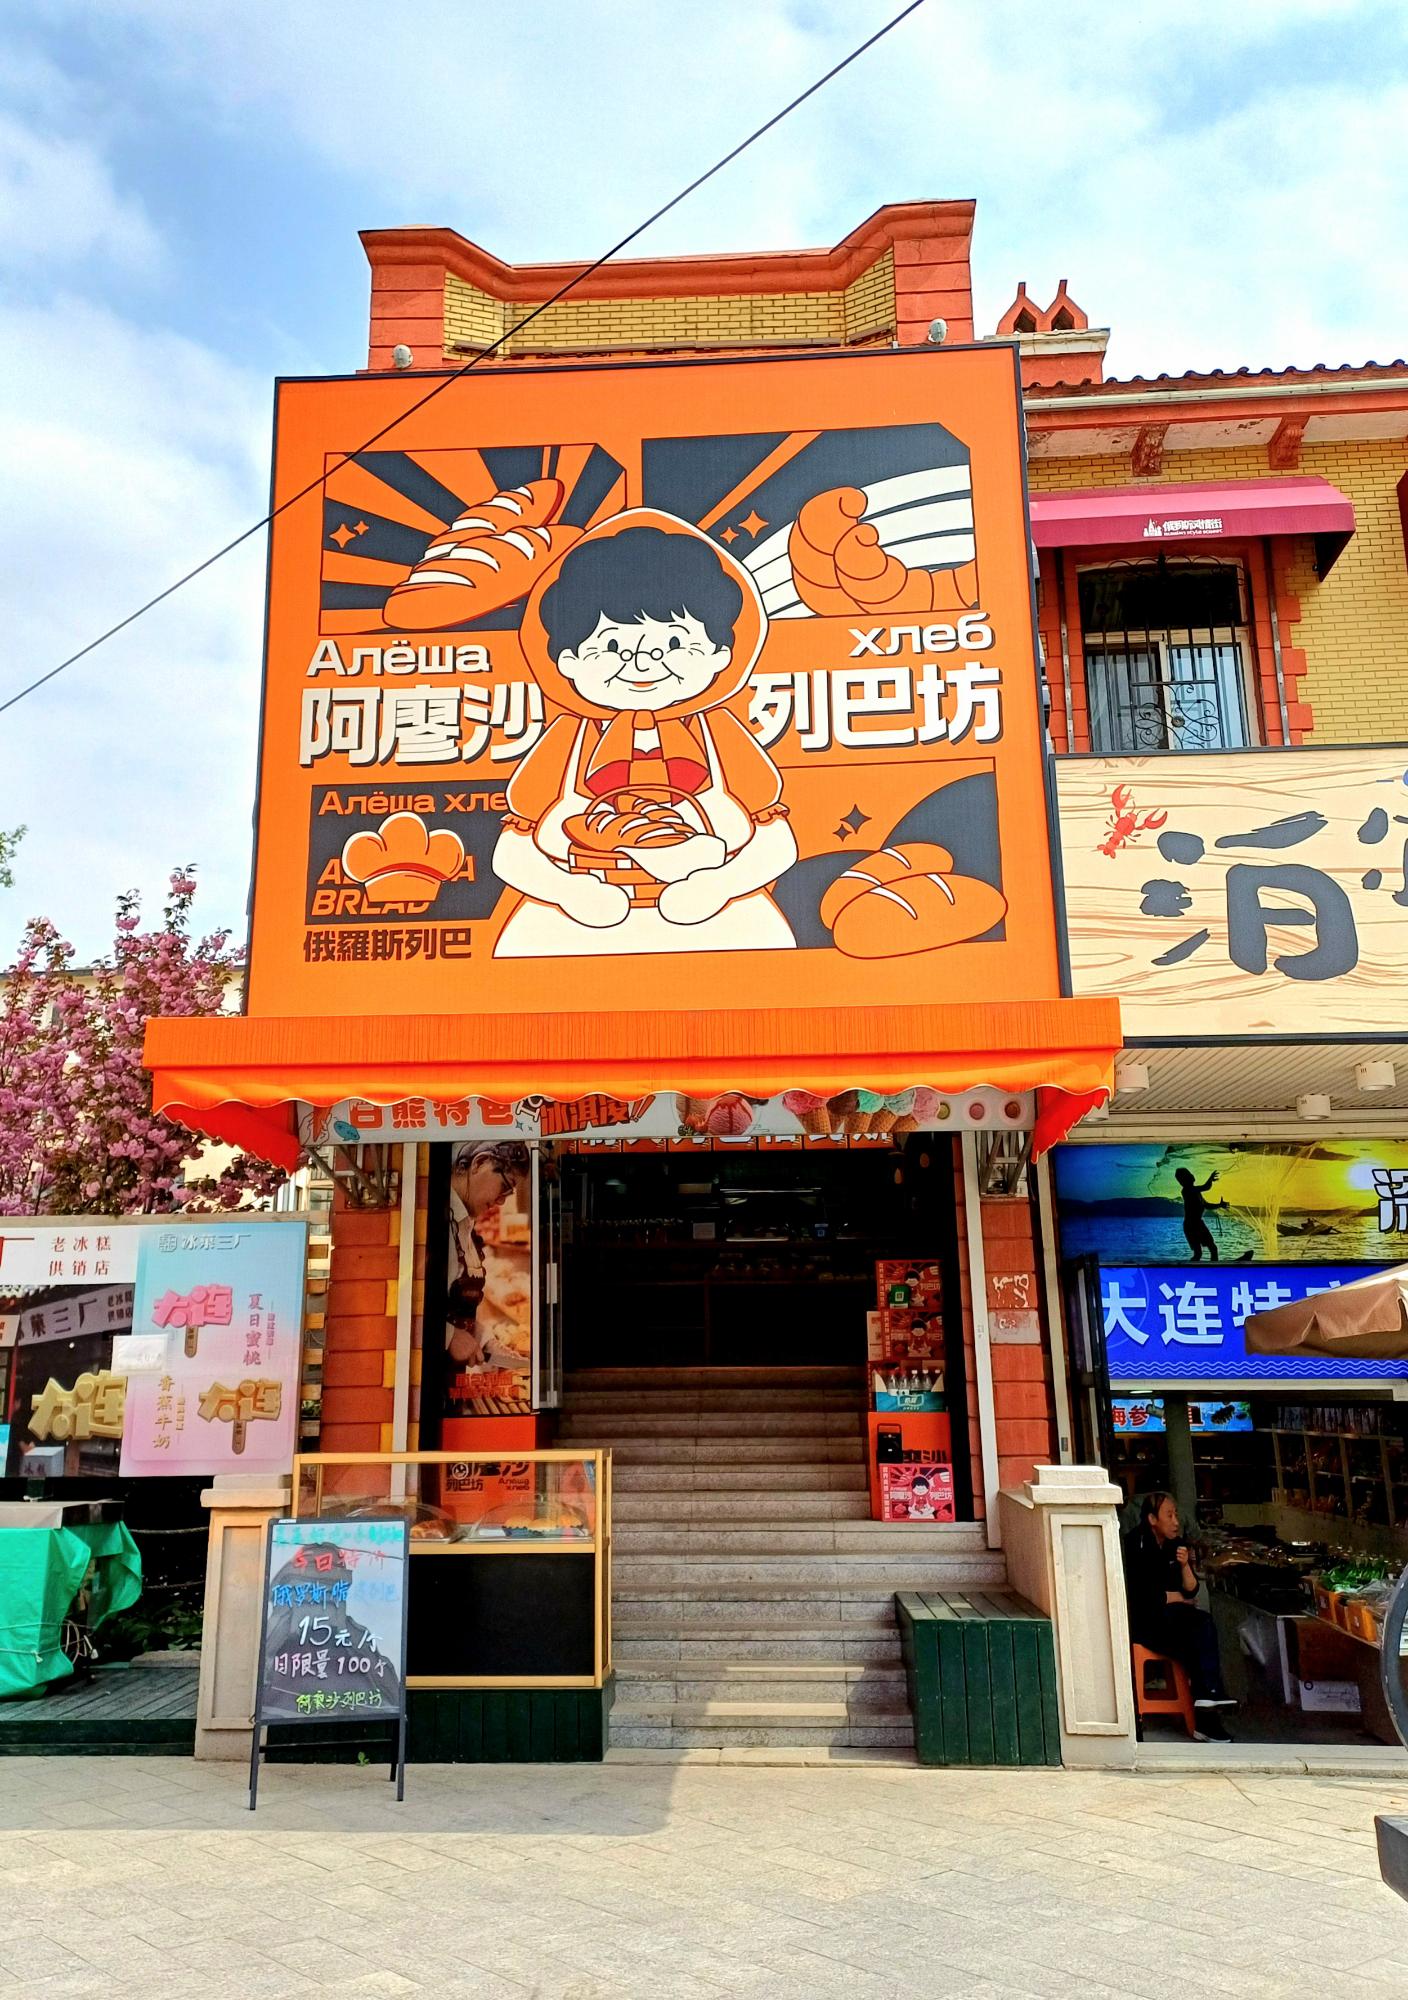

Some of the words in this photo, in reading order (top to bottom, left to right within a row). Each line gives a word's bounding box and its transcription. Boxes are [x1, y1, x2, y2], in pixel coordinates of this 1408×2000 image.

[848, 612, 994, 658] хлеб
[305, 639, 492, 678] Алёша
[748, 661, 1003, 752] 列巴坊
[318, 791, 436, 816] Алёша
[444, 792, 508, 813] хле
[51, 1236, 111, 1253] 老冰糕
[49, 1260, 110, 1276] 供销店
[1102, 1281, 1345, 1345] 大连特
